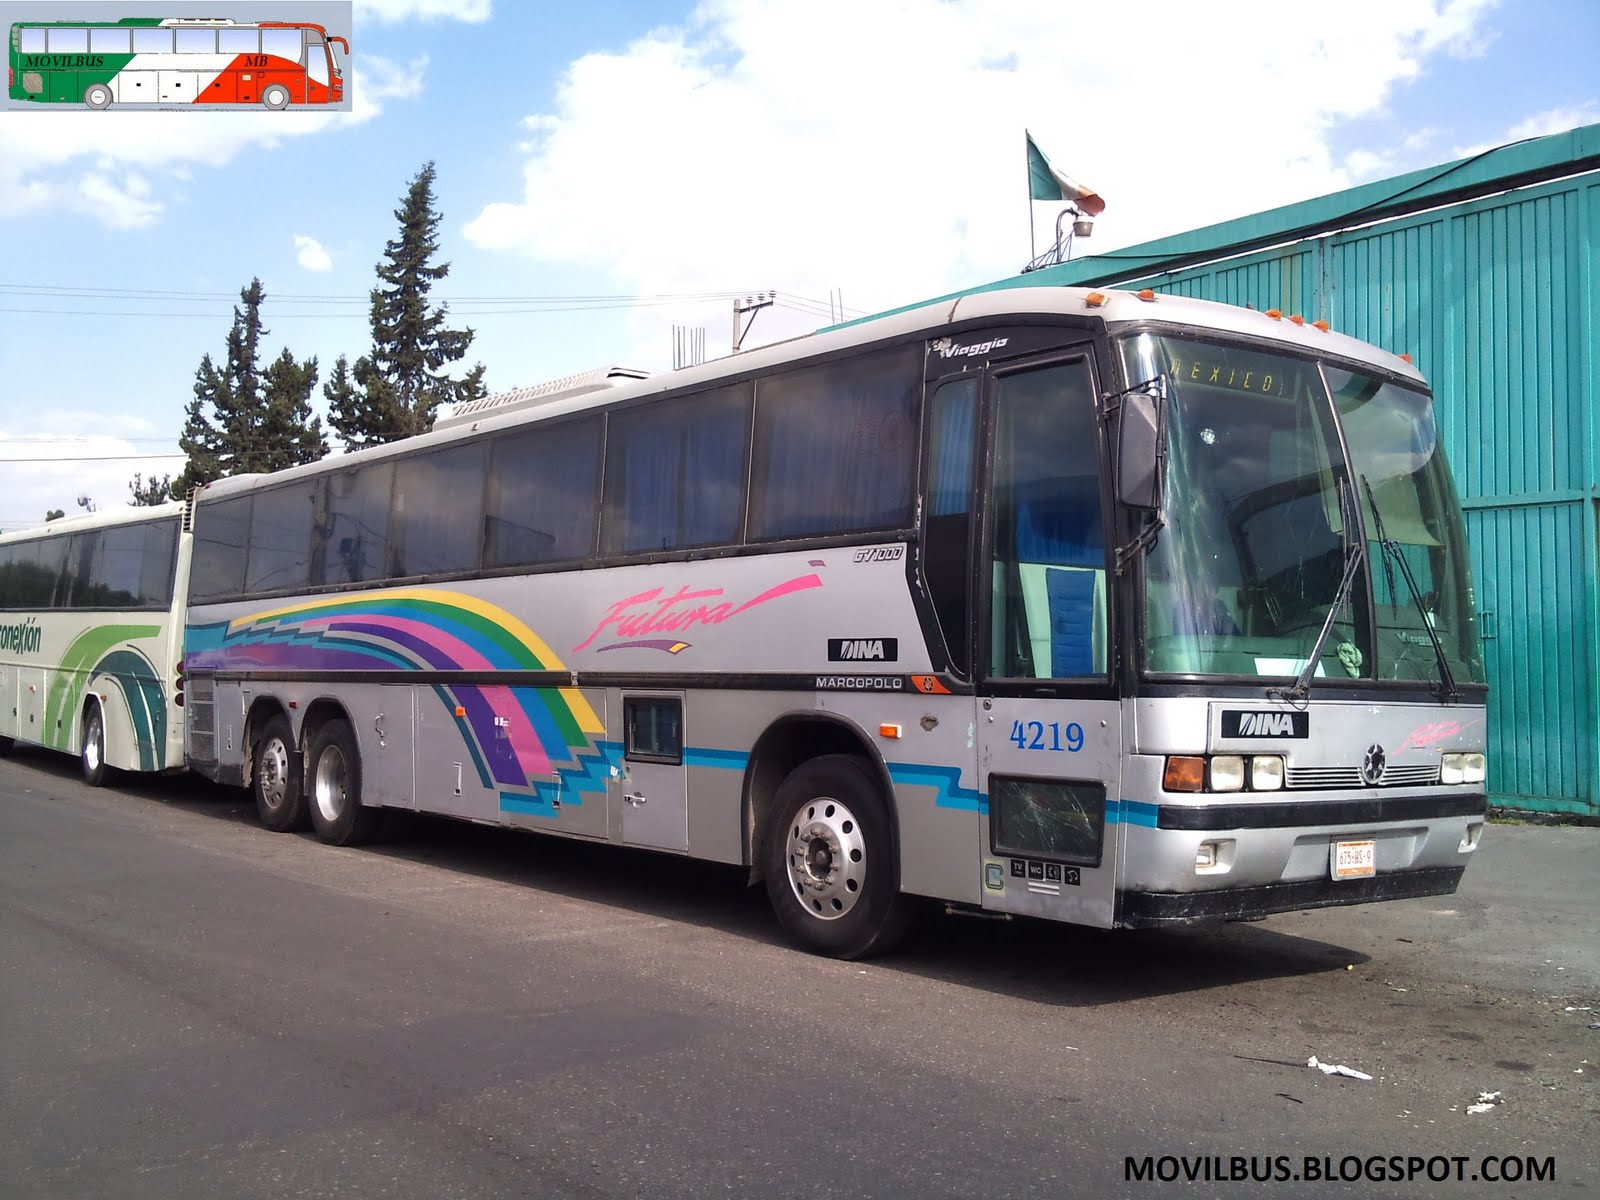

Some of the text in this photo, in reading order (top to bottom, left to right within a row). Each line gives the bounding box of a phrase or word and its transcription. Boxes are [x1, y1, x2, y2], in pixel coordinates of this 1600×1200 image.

[943, 337, 1008, 358] Viaggio
[572, 574, 824, 653] Futura
[0, 616, 42, 655] onexión
[1394, 631, 1443, 647] Viaggo
[840, 640, 885, 660] DINA
[816, 676, 902, 689] MARCOPOLO
[1238, 713, 1295, 736] DINA
[1010, 719, 1085, 753] 4219
[1013, 862, 1023, 870] TV
[1030, 866, 1042, 875] WC
